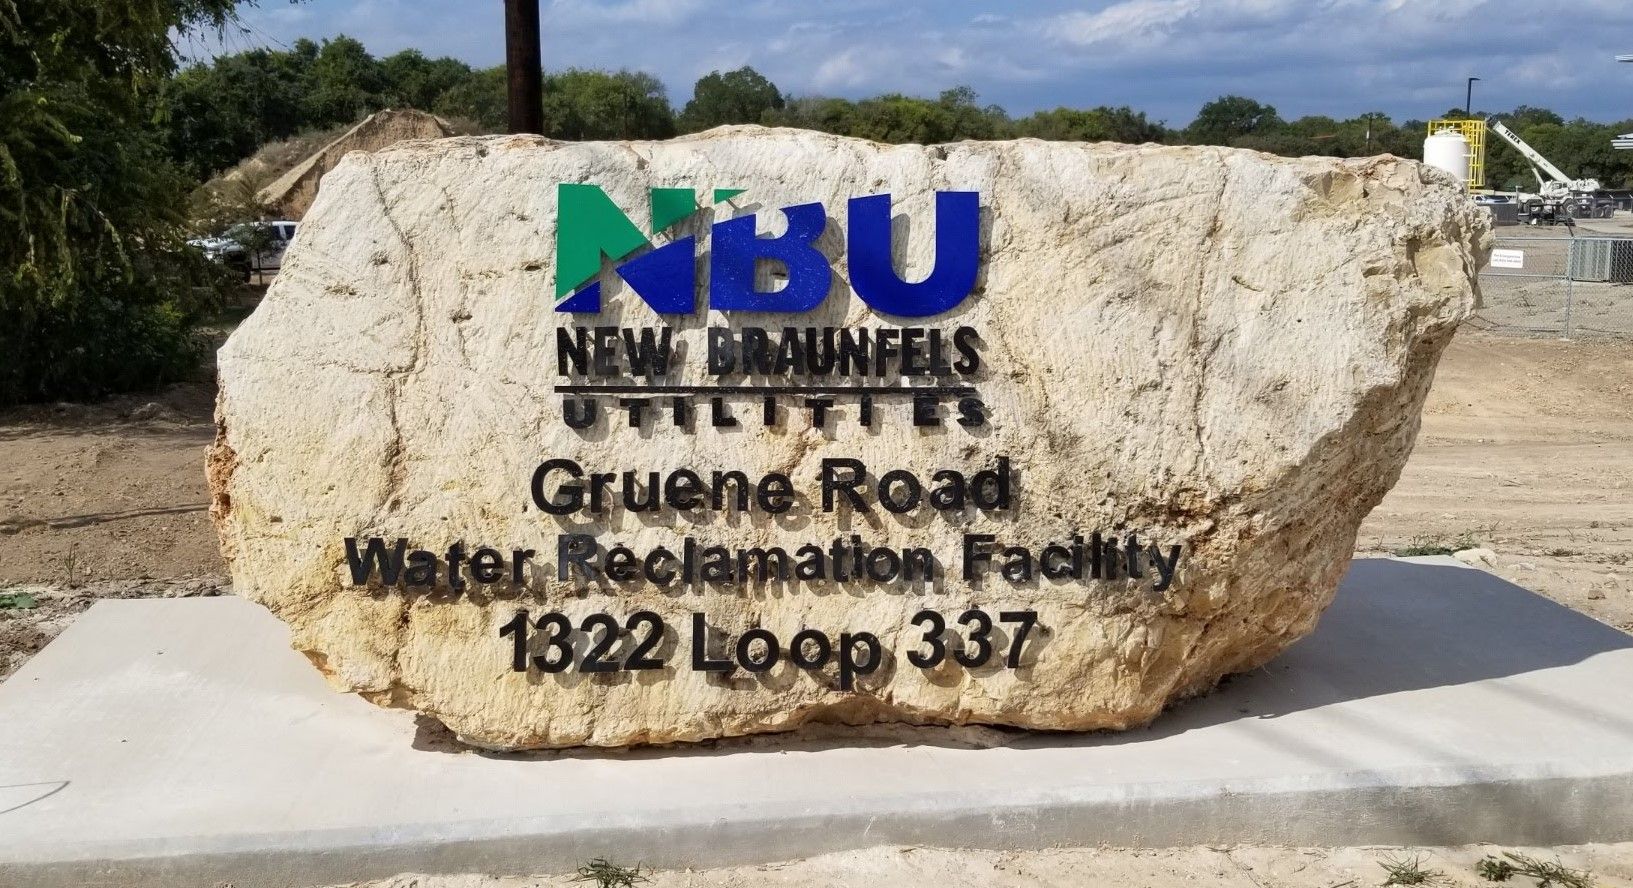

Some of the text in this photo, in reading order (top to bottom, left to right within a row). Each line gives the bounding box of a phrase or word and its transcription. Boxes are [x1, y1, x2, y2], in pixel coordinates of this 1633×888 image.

[1504, 129, 1521, 145] TEREX
[555, 183, 980, 317] NBU
[556, 326, 980, 377] NEW BRAUNFELS
[562, 393, 986, 429] UTILITIES
[531, 456, 1010, 515] Gruene Road
[344, 533, 1182, 591] Water Reclamation Facility
[499, 609, 1038, 691] 1322 Loop 337
